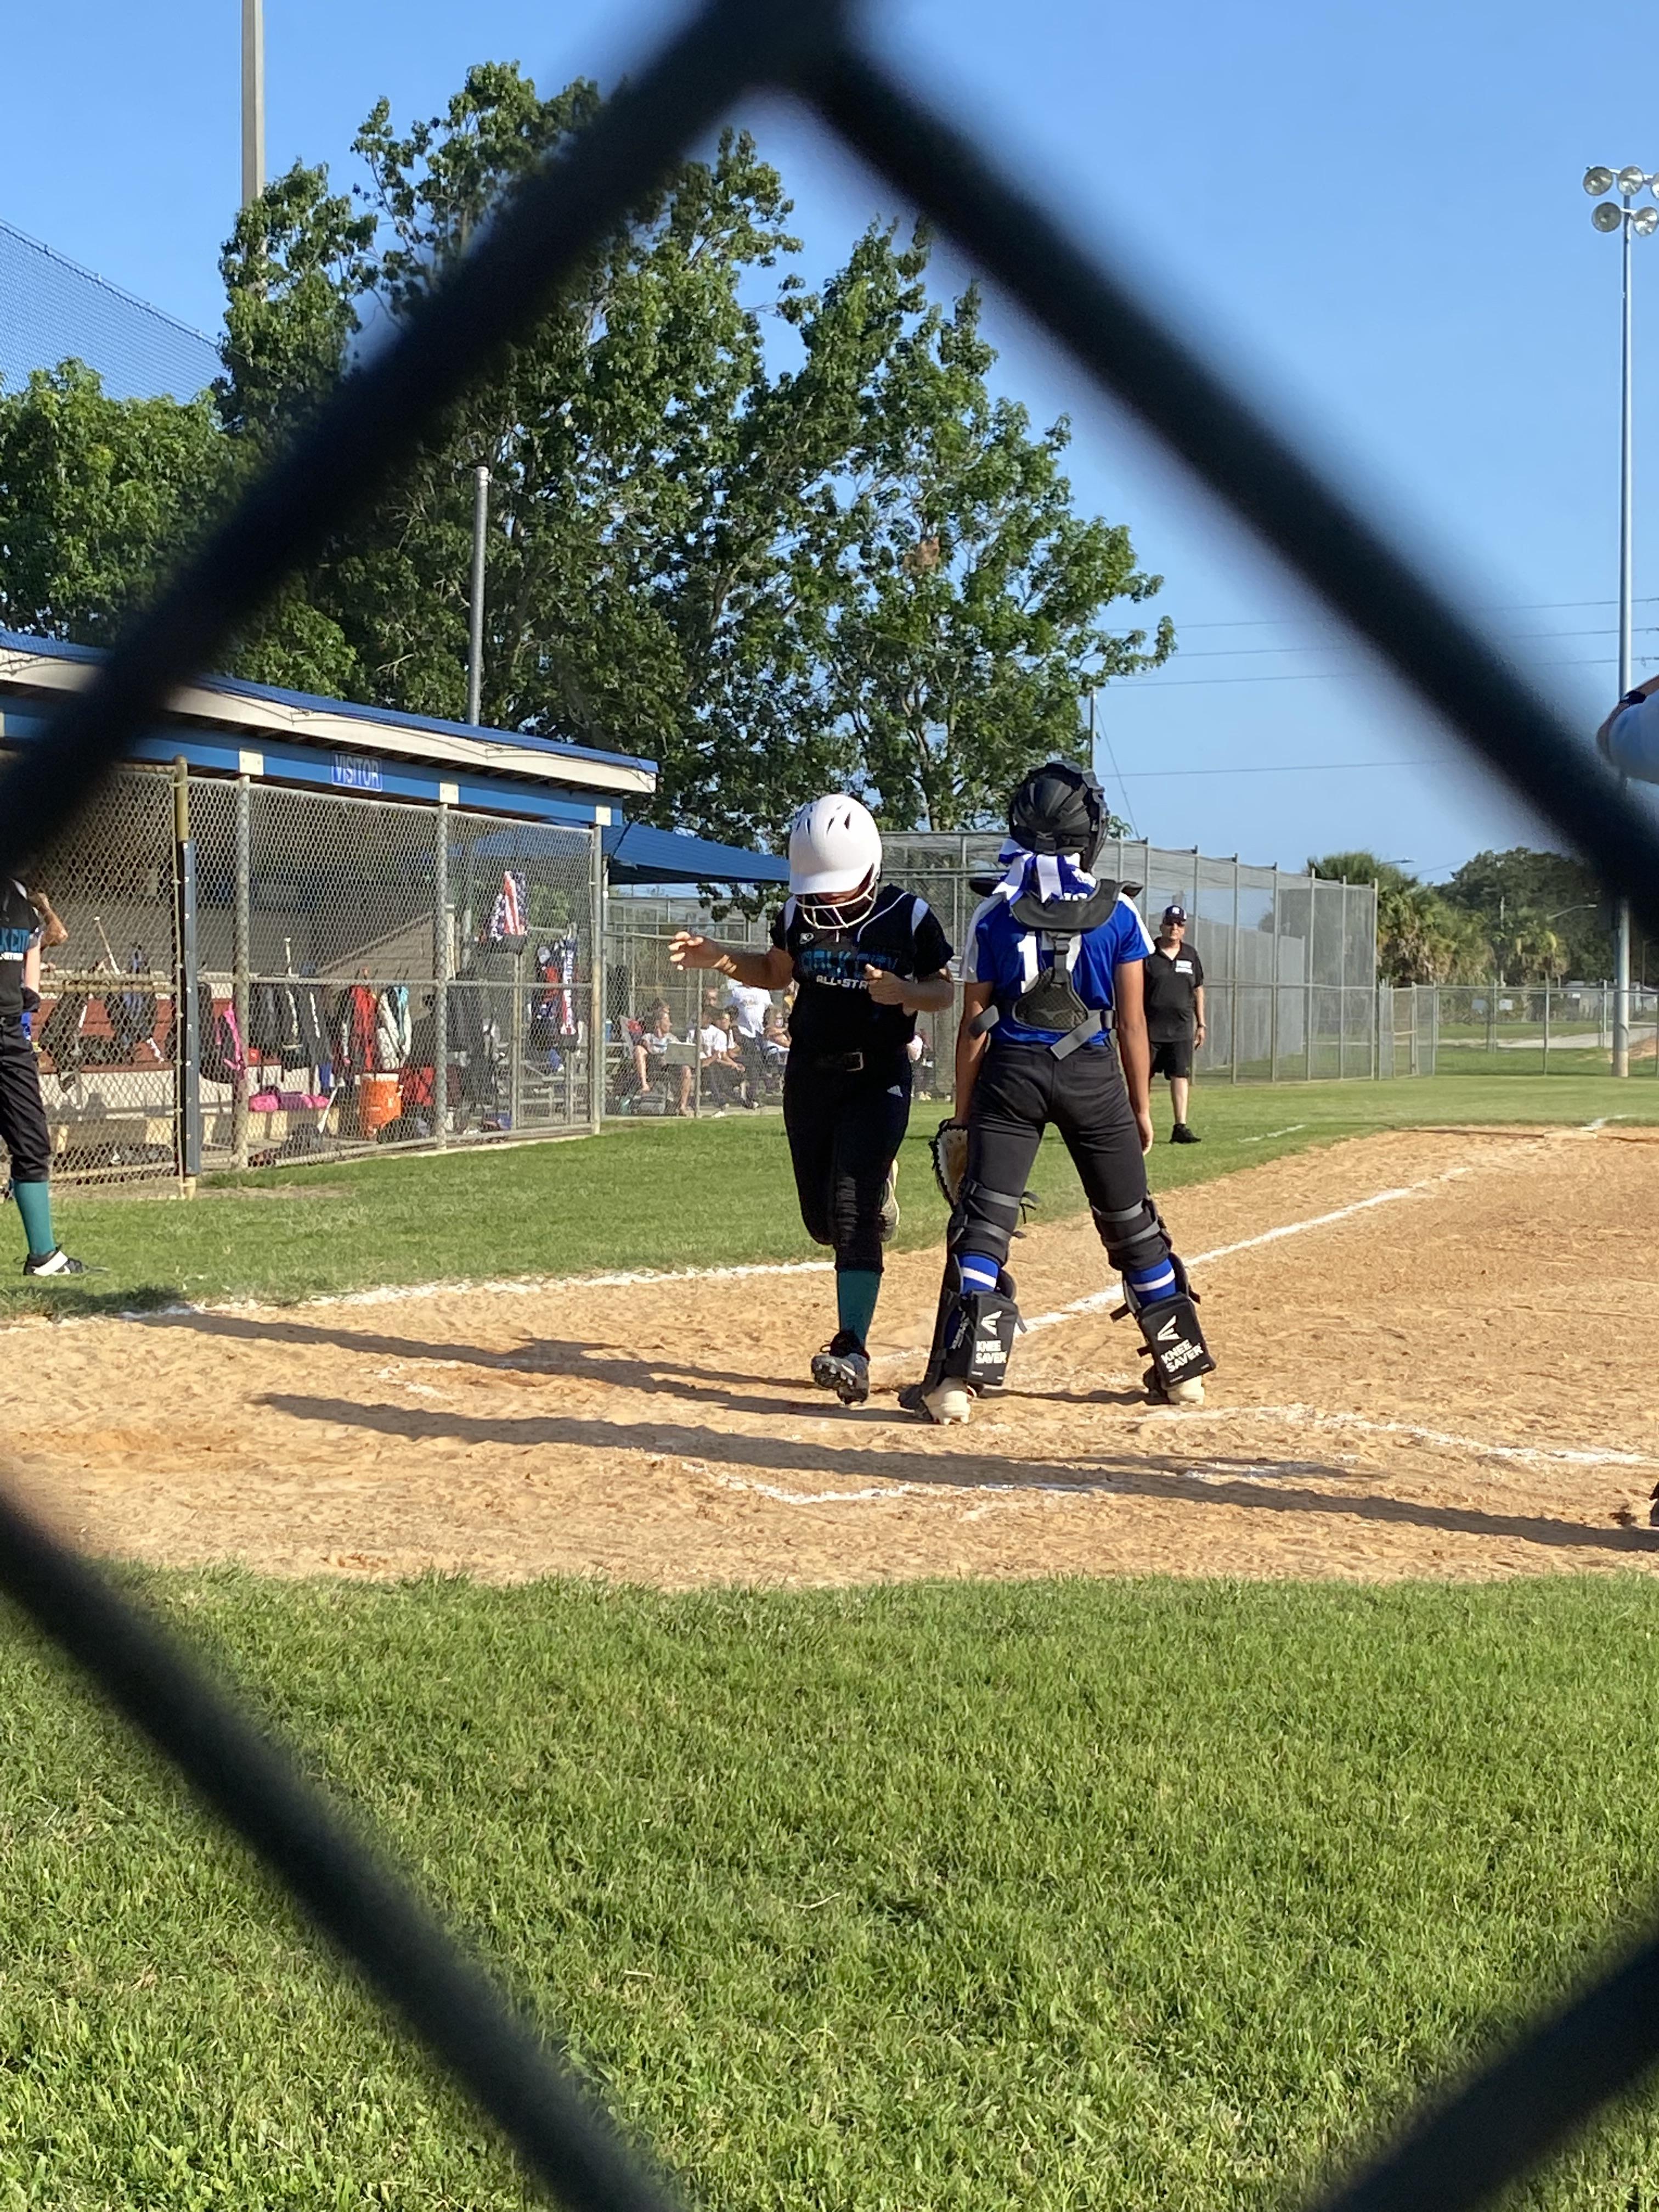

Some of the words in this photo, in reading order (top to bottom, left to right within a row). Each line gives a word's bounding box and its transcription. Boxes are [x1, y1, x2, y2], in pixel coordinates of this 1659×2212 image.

[334, 754, 380, 788] VISITOR
[975, 1352, 1007, 1363] SAVER
[976, 1340, 1002, 1352] KNEE
[1160, 1339, 1193, 1364] KNEE
[1166, 1345, 1204, 1373] SAVER
